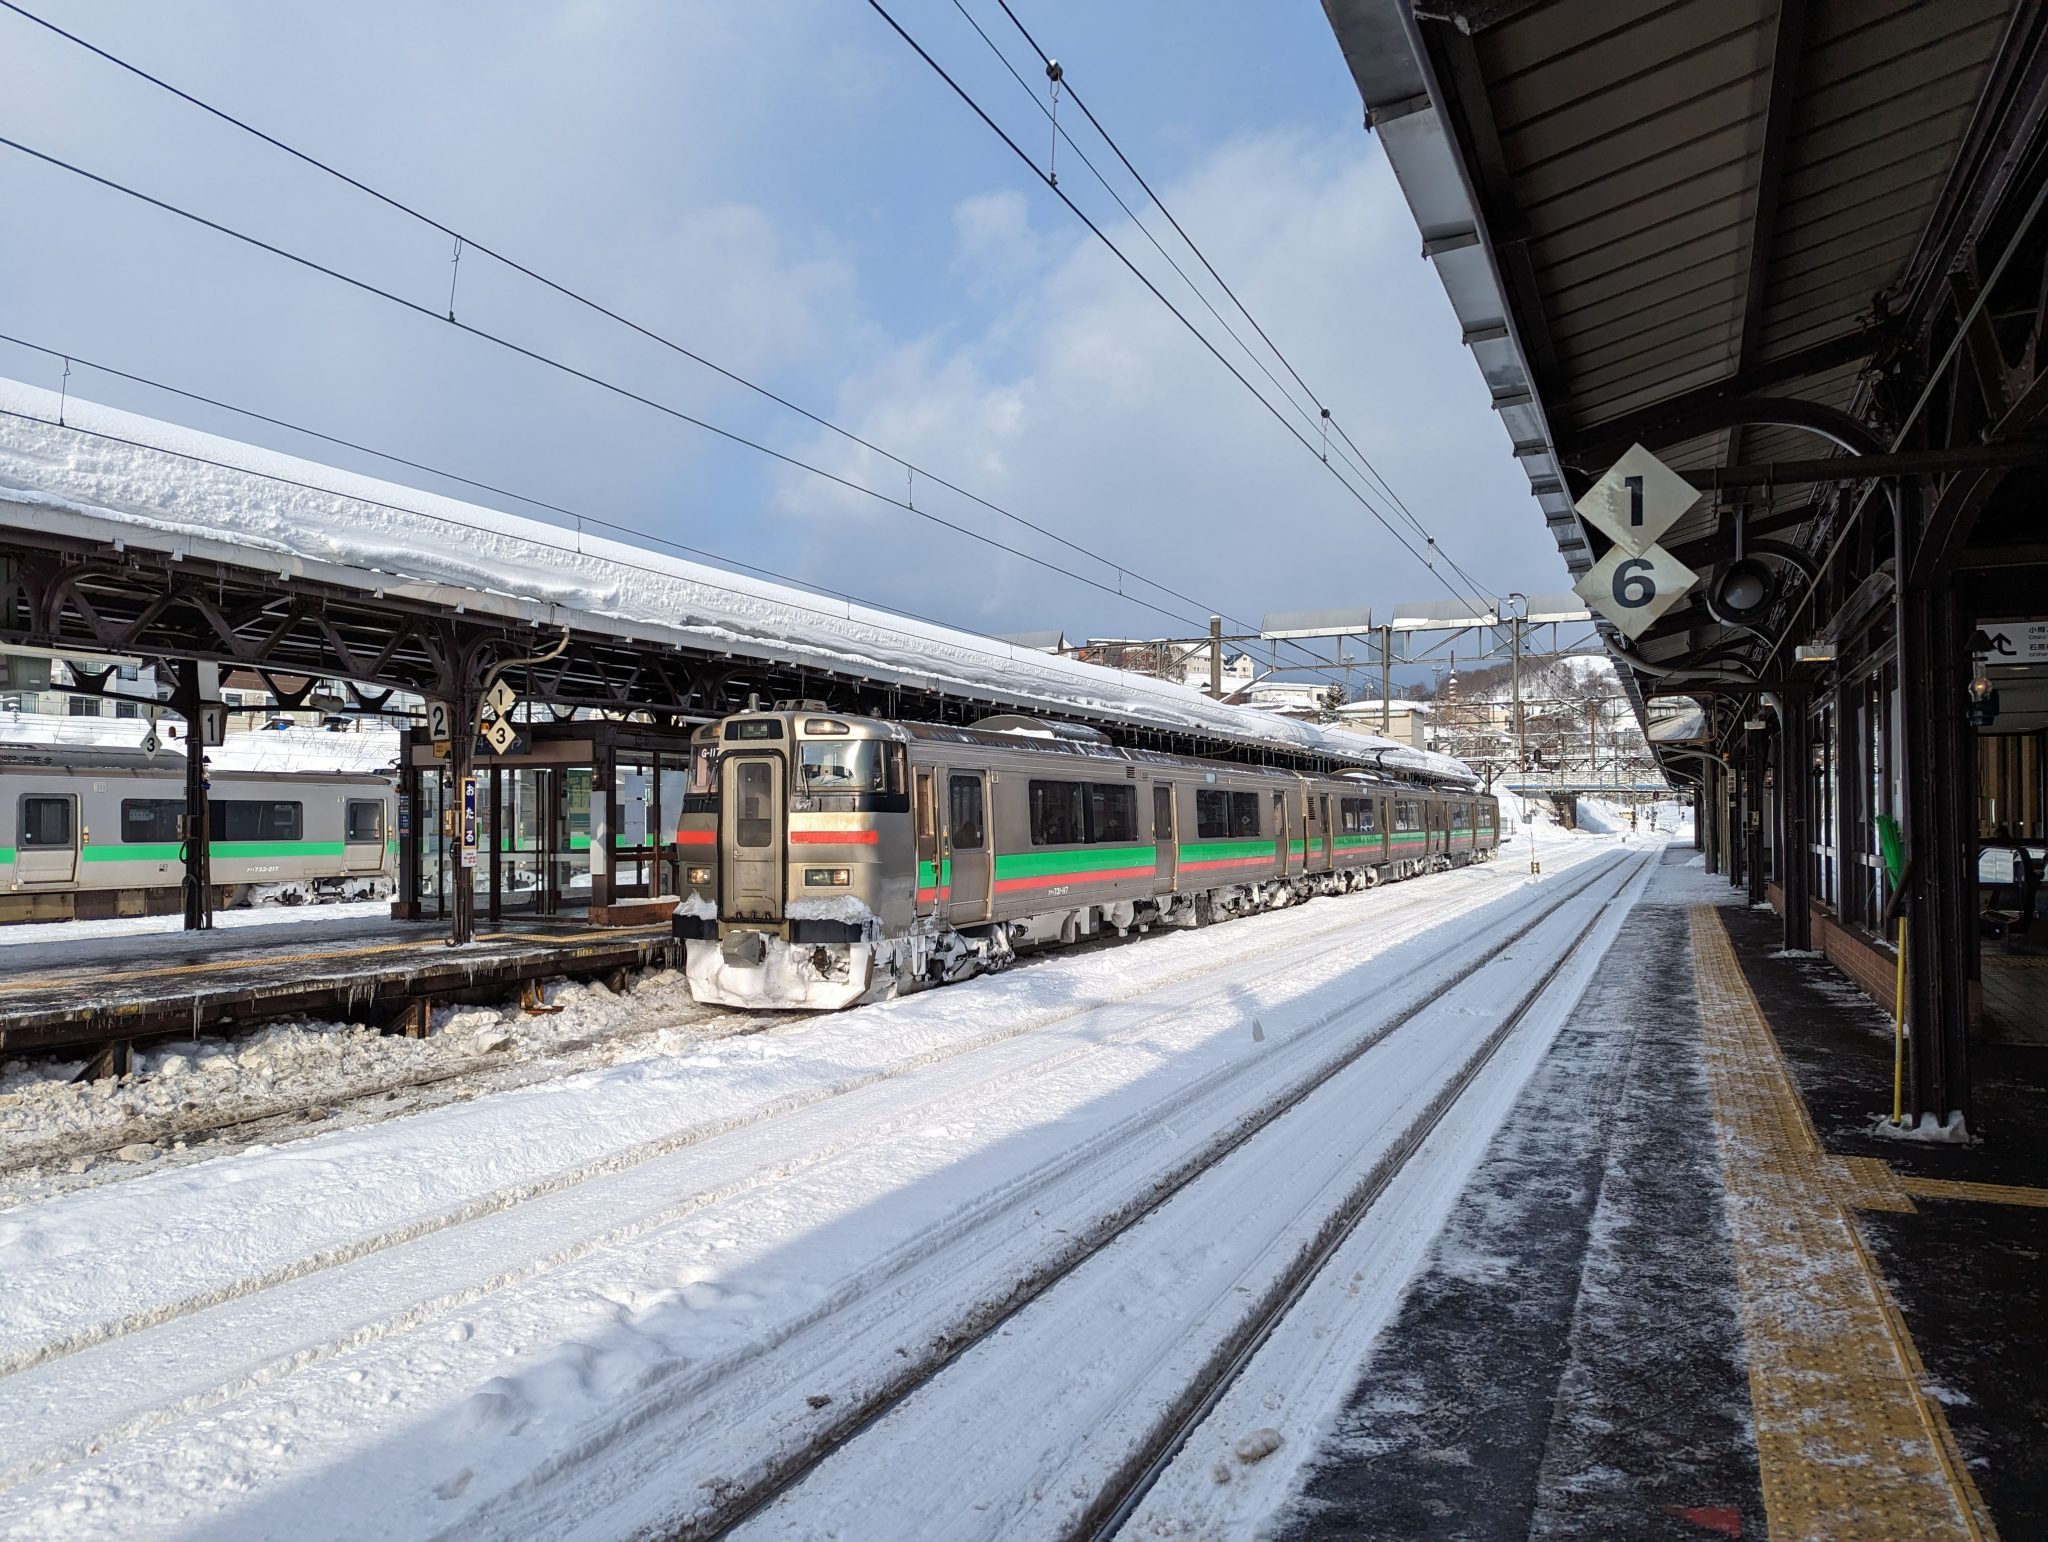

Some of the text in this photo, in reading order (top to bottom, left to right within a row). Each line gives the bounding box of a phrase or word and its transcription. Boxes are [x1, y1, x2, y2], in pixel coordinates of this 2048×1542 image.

[1624, 475, 1644, 527] 1
[1612, 558, 1656, 609] 6
[497, 689, 503, 705] 1
[207, 713, 214, 742] 1
[432, 706, 446, 736] 2
[495, 727, 506, 744] 3
[146, 737, 155, 752] 3
[465, 783, 475, 843] おたる
